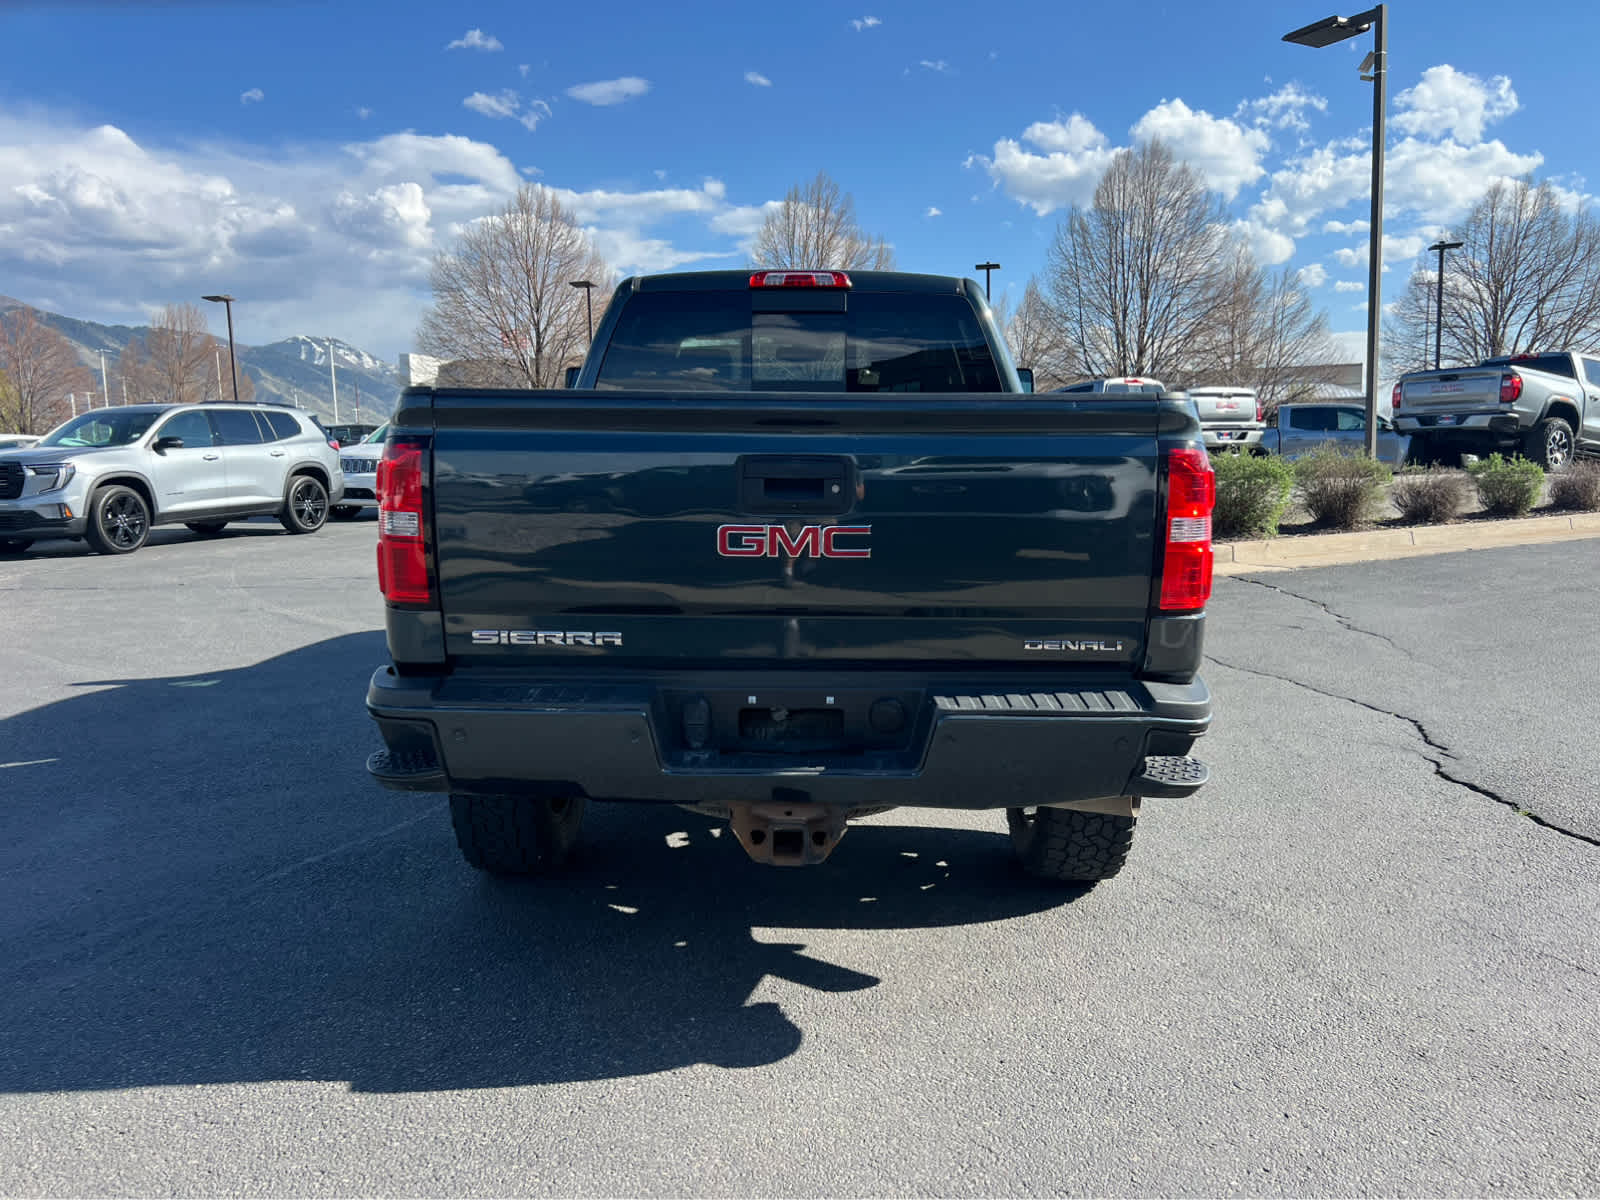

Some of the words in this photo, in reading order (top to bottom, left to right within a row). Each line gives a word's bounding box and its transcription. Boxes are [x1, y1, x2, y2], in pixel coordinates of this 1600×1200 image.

[717, 524, 872, 558] GMC
[471, 630, 623, 646] SIERRA
[1023, 640, 1122, 651] DENALI
